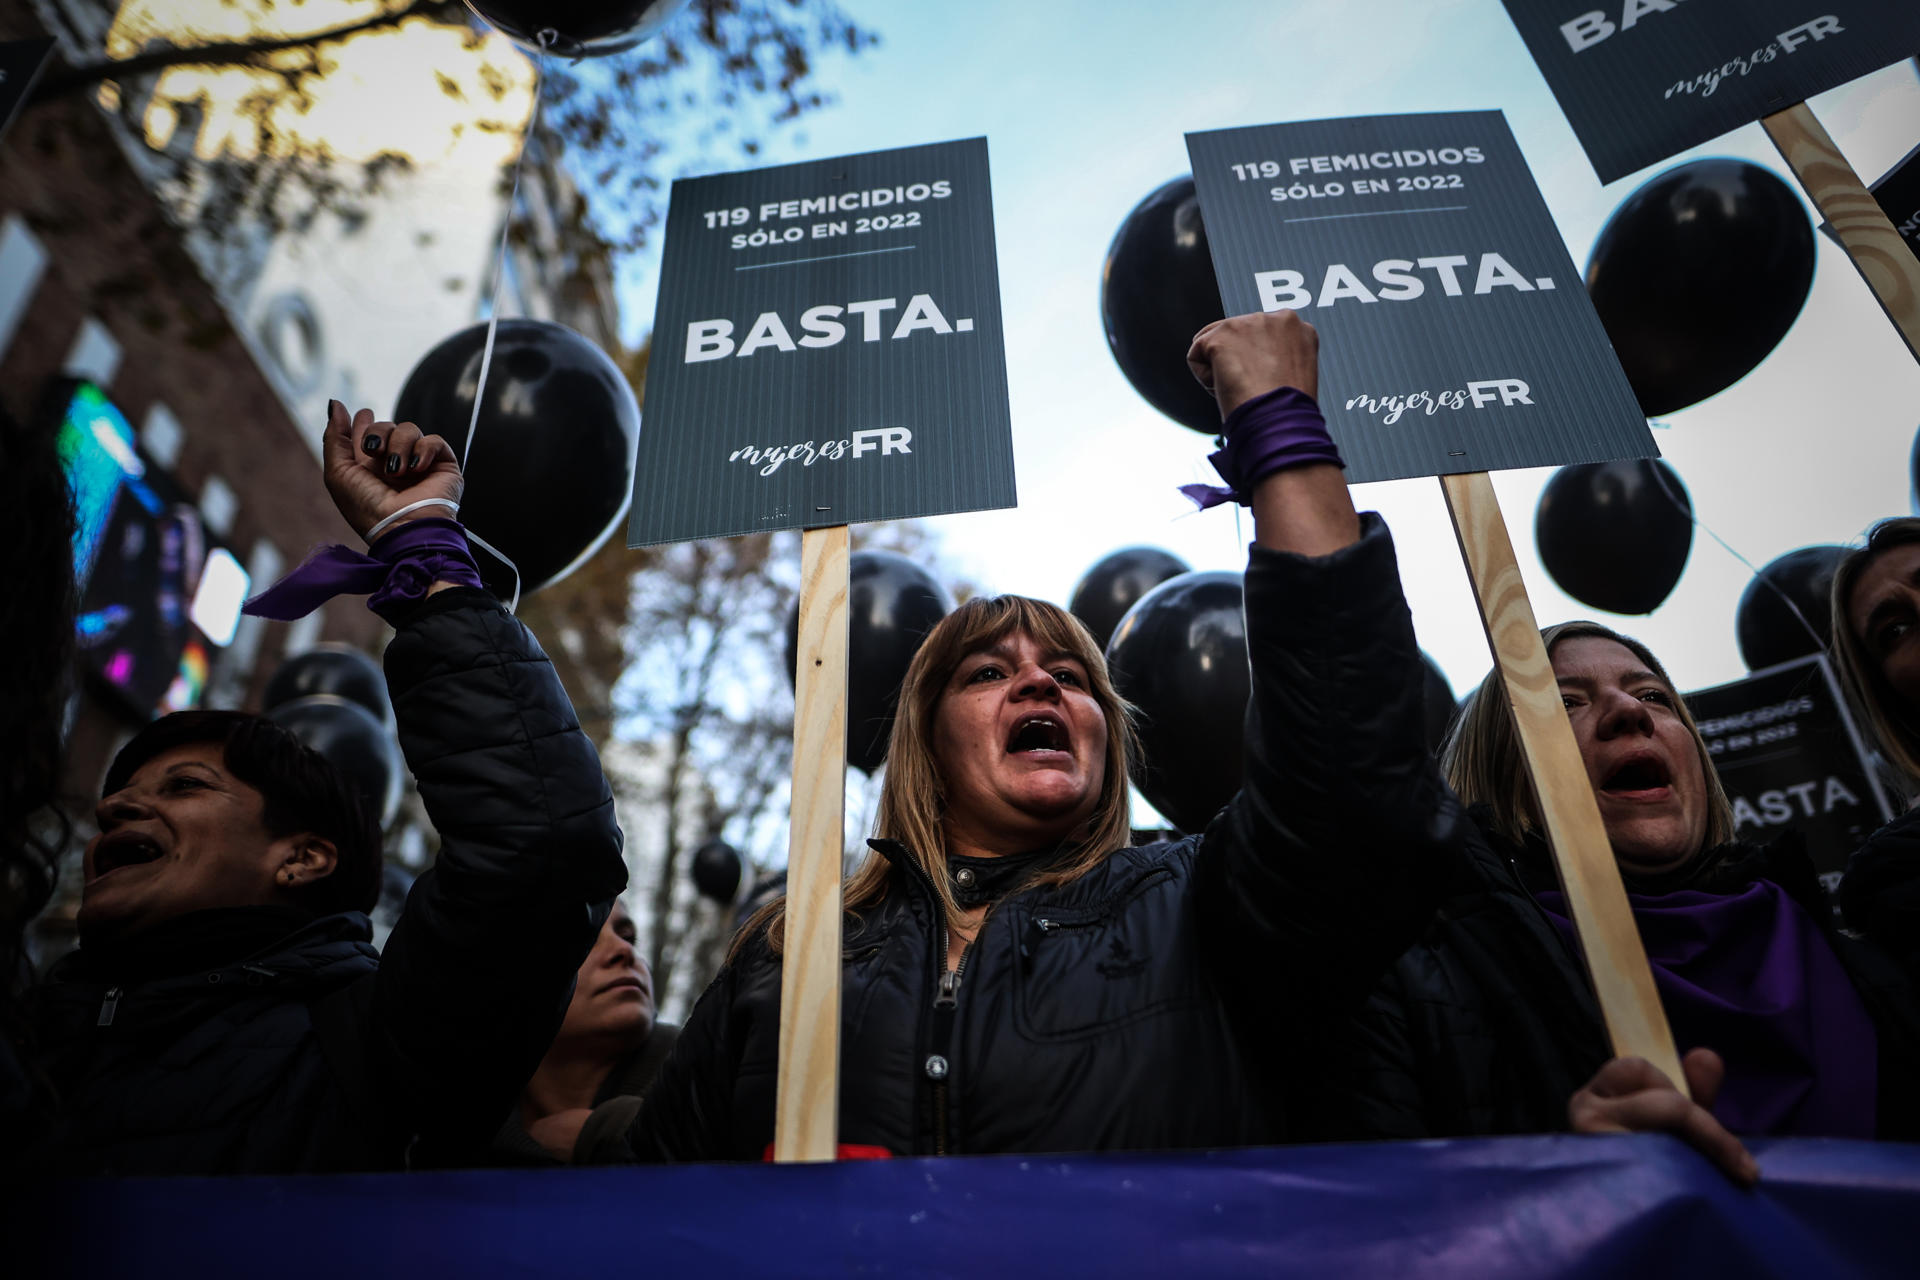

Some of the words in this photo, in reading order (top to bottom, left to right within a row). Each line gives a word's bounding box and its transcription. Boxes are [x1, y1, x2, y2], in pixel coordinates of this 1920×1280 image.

[1664, 14, 1846, 100] mujeresFR
[1232, 161, 1280, 181] 119
[1290, 146, 1485, 177] FEMICIDIOS
[1270, 181, 1345, 202] SÓLO
[1354, 179, 1390, 196] EN
[1397, 174, 1464, 192] 2022
[704, 207, 750, 229] 119
[760, 180, 952, 222] FEMICIDIOS
[731, 226, 804, 250] SÓLO
[812, 221, 847, 240] EN
[855, 212, 922, 234] 2022
[1254, 252, 1556, 313] BASTA.
[684, 294, 974, 364] BASTA.
[1345, 378, 1535, 425] mujeresFR
[728, 426, 913, 477] mujeresFR
[1733, 775, 1858, 831] ASTA
